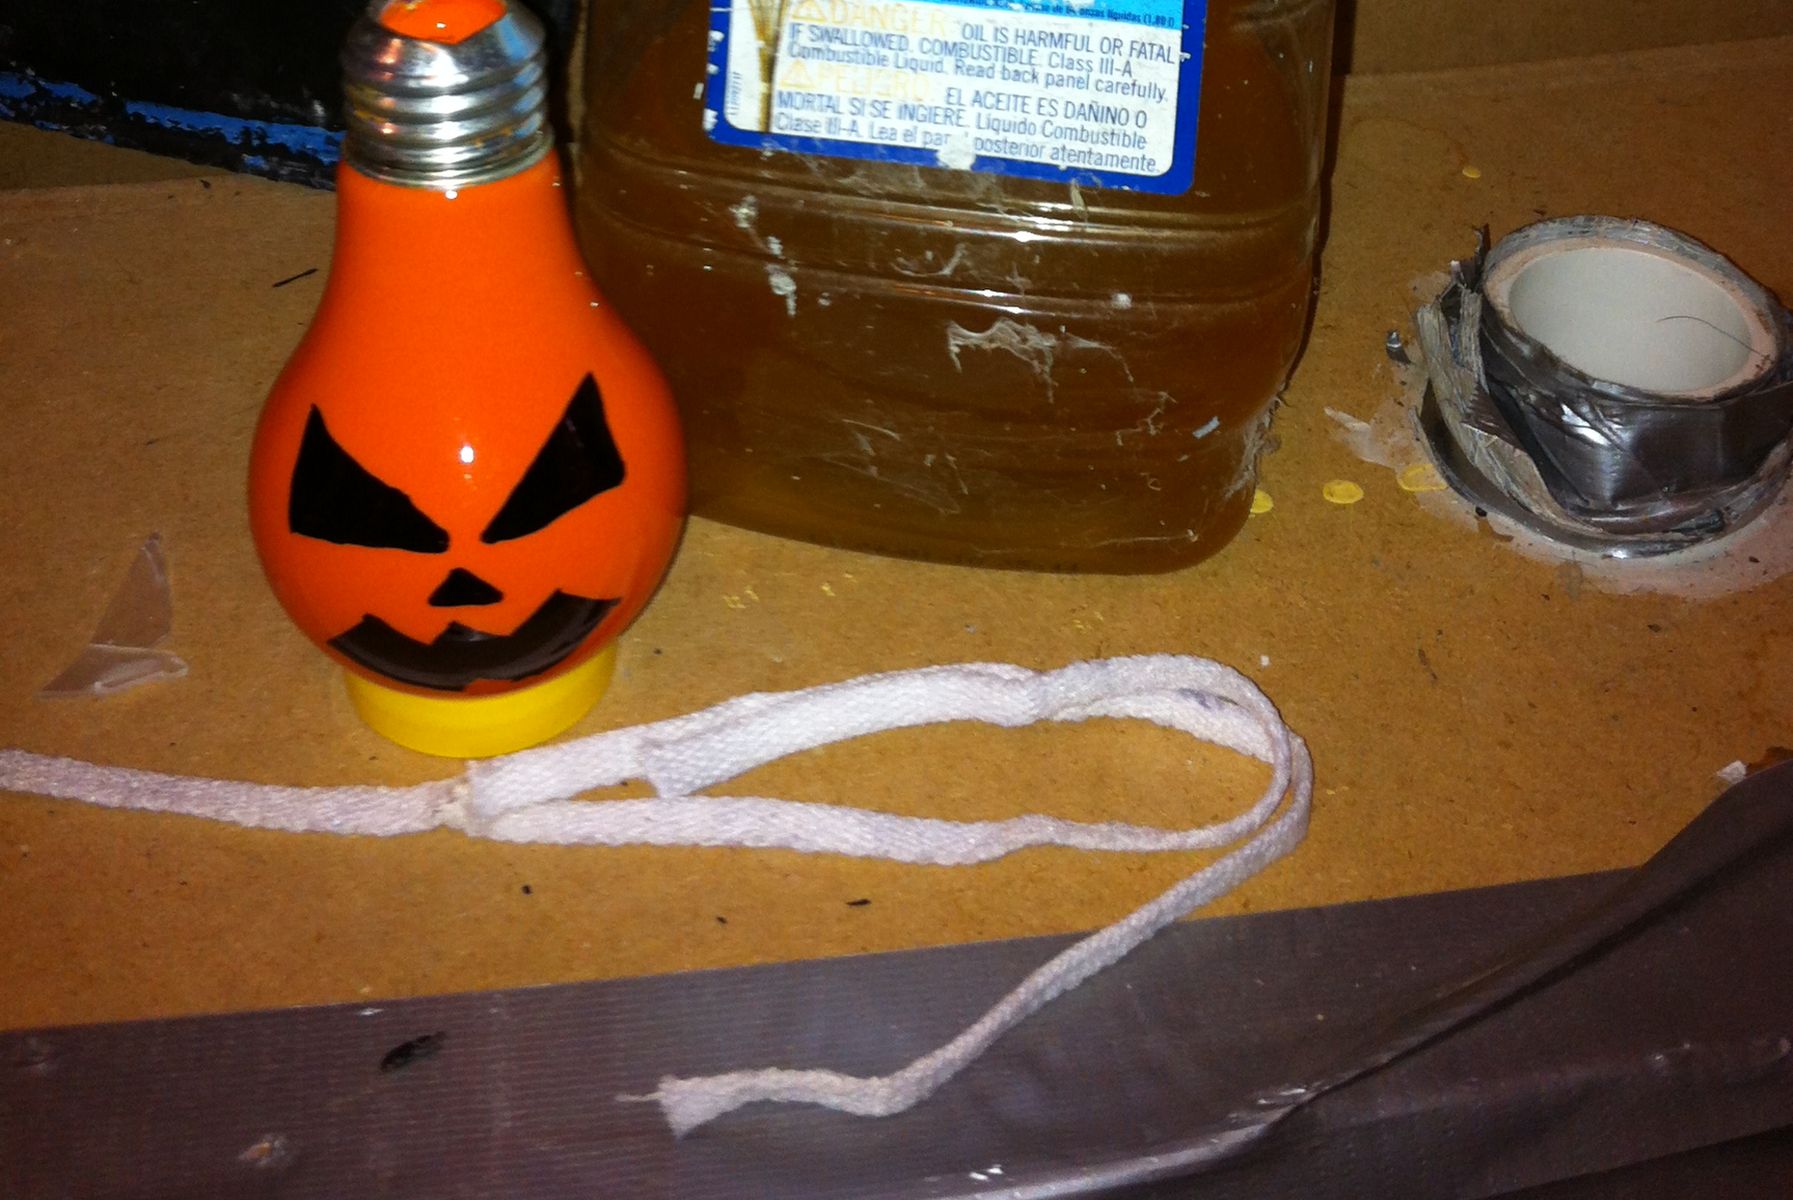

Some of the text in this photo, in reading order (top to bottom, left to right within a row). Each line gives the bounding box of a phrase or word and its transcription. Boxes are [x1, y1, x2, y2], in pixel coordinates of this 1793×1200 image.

[790, 22, 804, 39] IF
[1048, 50, 1094, 73] Class
[1099, 58, 1133, 78] III-A
[961, 22, 987, 42] OIL
[993, 26, 1009, 44] IS
[1015, 28, 1095, 54] HARMFUL
[1100, 36, 1124, 57] OR
[1128, 40, 1176, 65] FATAL
[788, 41, 890, 67] Combustible
[954, 58, 996, 80] Read
[1002, 64, 1039, 85] back
[1044, 71, 1090, 91] panel
[1095, 78, 1168, 104] carefully.
[776, 90, 844, 115] MORTAL
[849, 96, 865, 116] SI
[869, 99, 893, 120] SE
[1041, 119, 1148, 150] Combustible
[945, 86, 966, 106] EL
[971, 89, 1032, 115] ACEITE
[1036, 97, 1059, 119] ES
[1064, 99, 1130, 127] DAÑINO
[1135, 109, 1148, 129] O
[774, 111, 822, 134] Clase
[869, 120, 898, 141] Lea
[902, 125, 918, 144] el
[974, 135, 1045, 158] posterior
